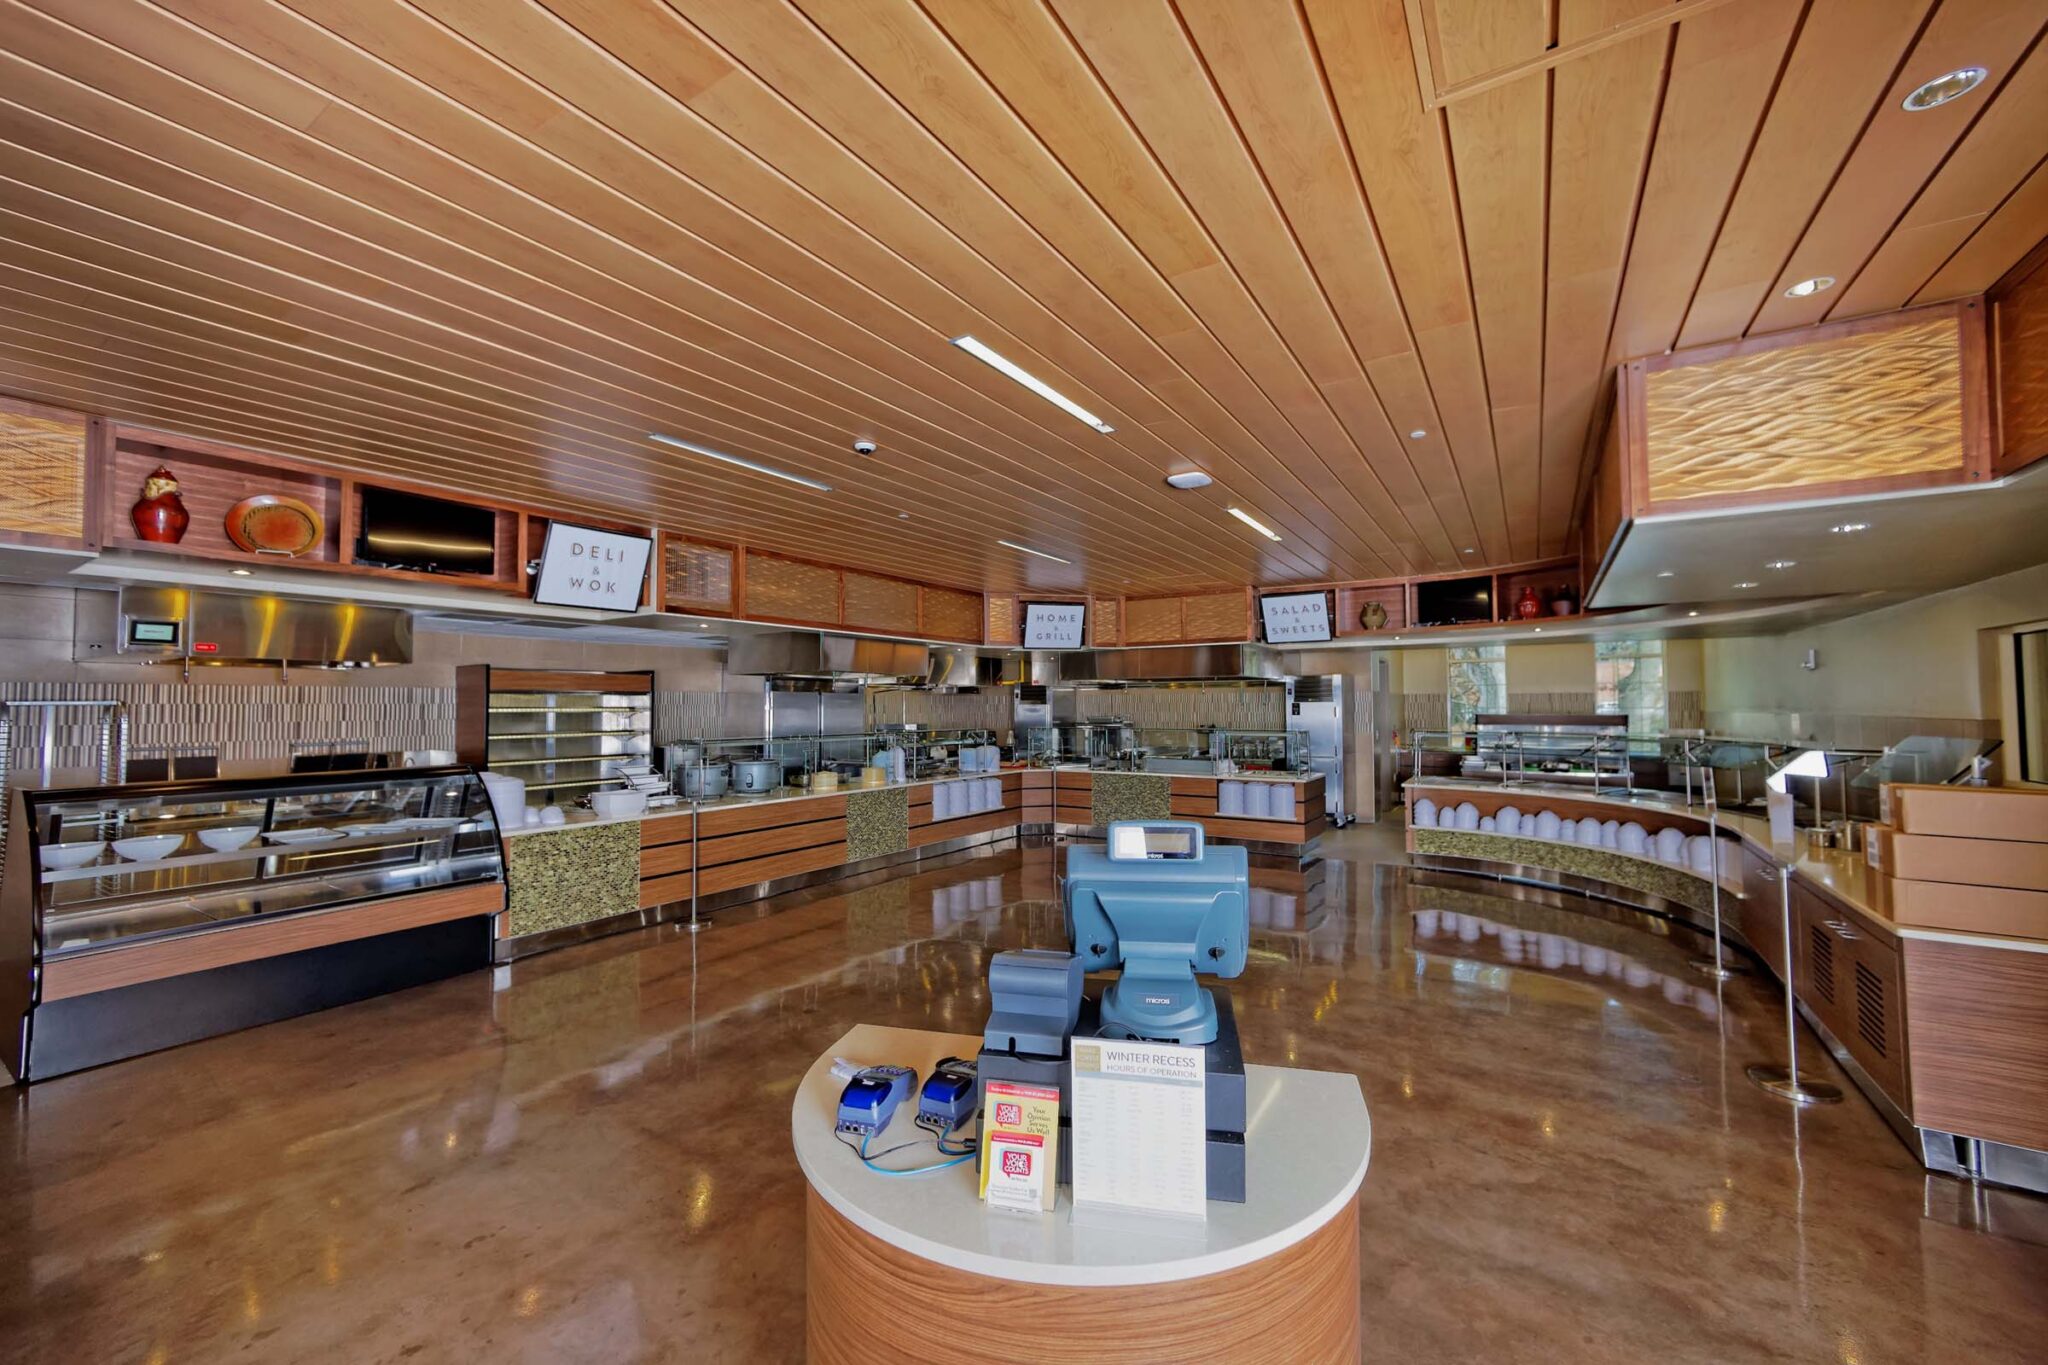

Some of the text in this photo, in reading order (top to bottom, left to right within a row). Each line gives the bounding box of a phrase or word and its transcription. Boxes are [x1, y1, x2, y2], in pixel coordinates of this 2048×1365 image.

[572, 542, 624, 562] DELI
[592, 565, 600, 576] &
[569, 577, 616, 593] WOK
[1271, 603, 1321, 616] SALAD
[1036, 613, 1077, 623] HOME
[1271, 624, 1326, 635] SWEETS
[1036, 632, 1073, 641] GRILL
[1106, 1051, 1150, 1064] WINTER
[1152, 1054, 1196, 1068] RECESS
[1106, 1064, 1197, 1078] HOURS OF OPERATION
[1007, 1152, 1027, 1160] YOUR
[1004, 1166, 1029, 1174] COUNTS
